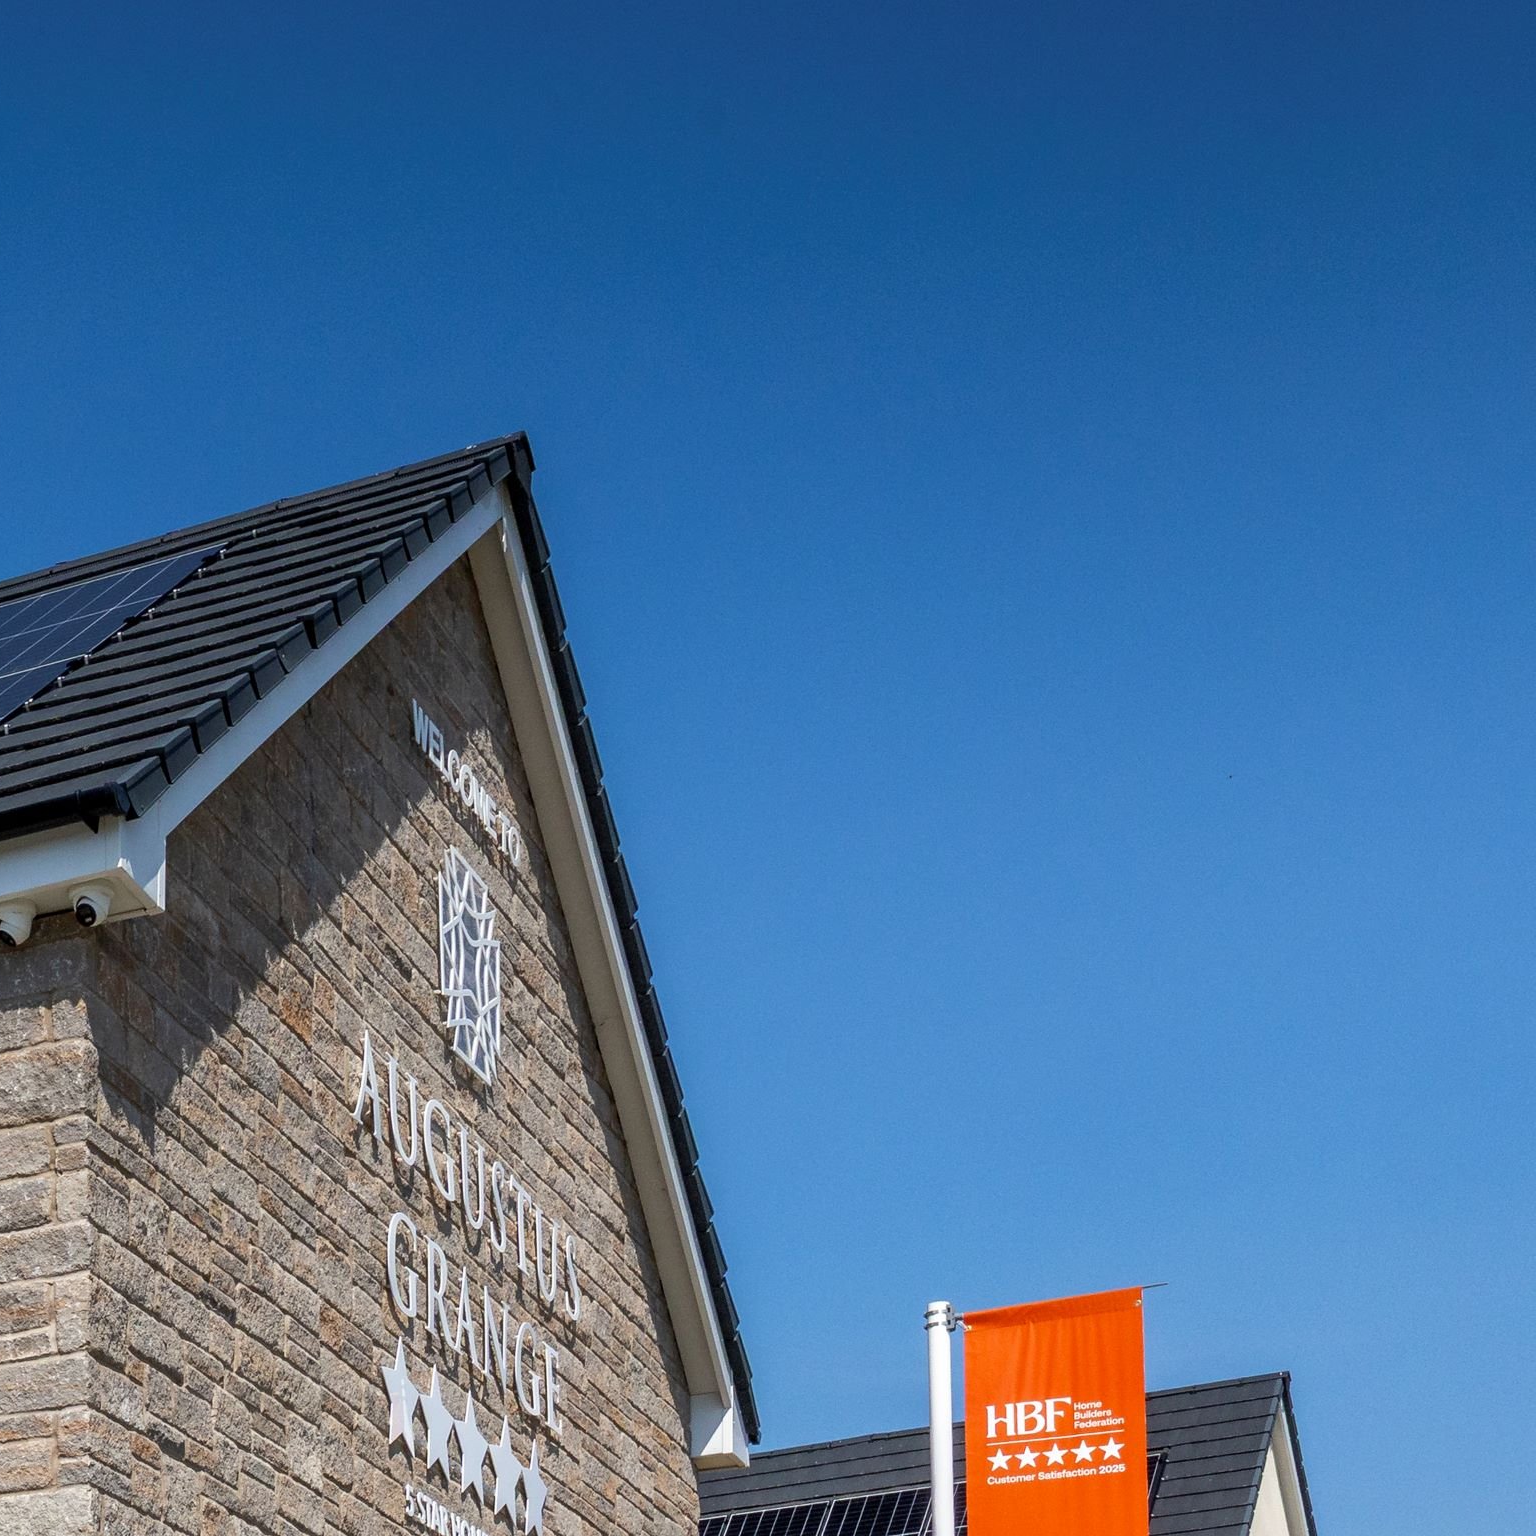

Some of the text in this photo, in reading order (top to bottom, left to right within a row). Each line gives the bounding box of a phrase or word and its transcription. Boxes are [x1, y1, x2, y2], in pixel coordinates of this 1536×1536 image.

[412, 698, 521, 867] WELCOME TO
[349, 1029, 582, 1322] AUGUSTUS
[387, 1212, 563, 1437] GRANGE
[985, 1396, 1072, 1439] HBF
[1073, 1401, 1103, 1411] Home
[1073, 1409, 1112, 1420] Builders
[1073, 1417, 1125, 1429] Federation
[986, 1463, 1126, 1486] Customer Satisfaction 2025
[405, 1483, 415, 1517] 5
[416, 1491, 450, 1536] STAR
